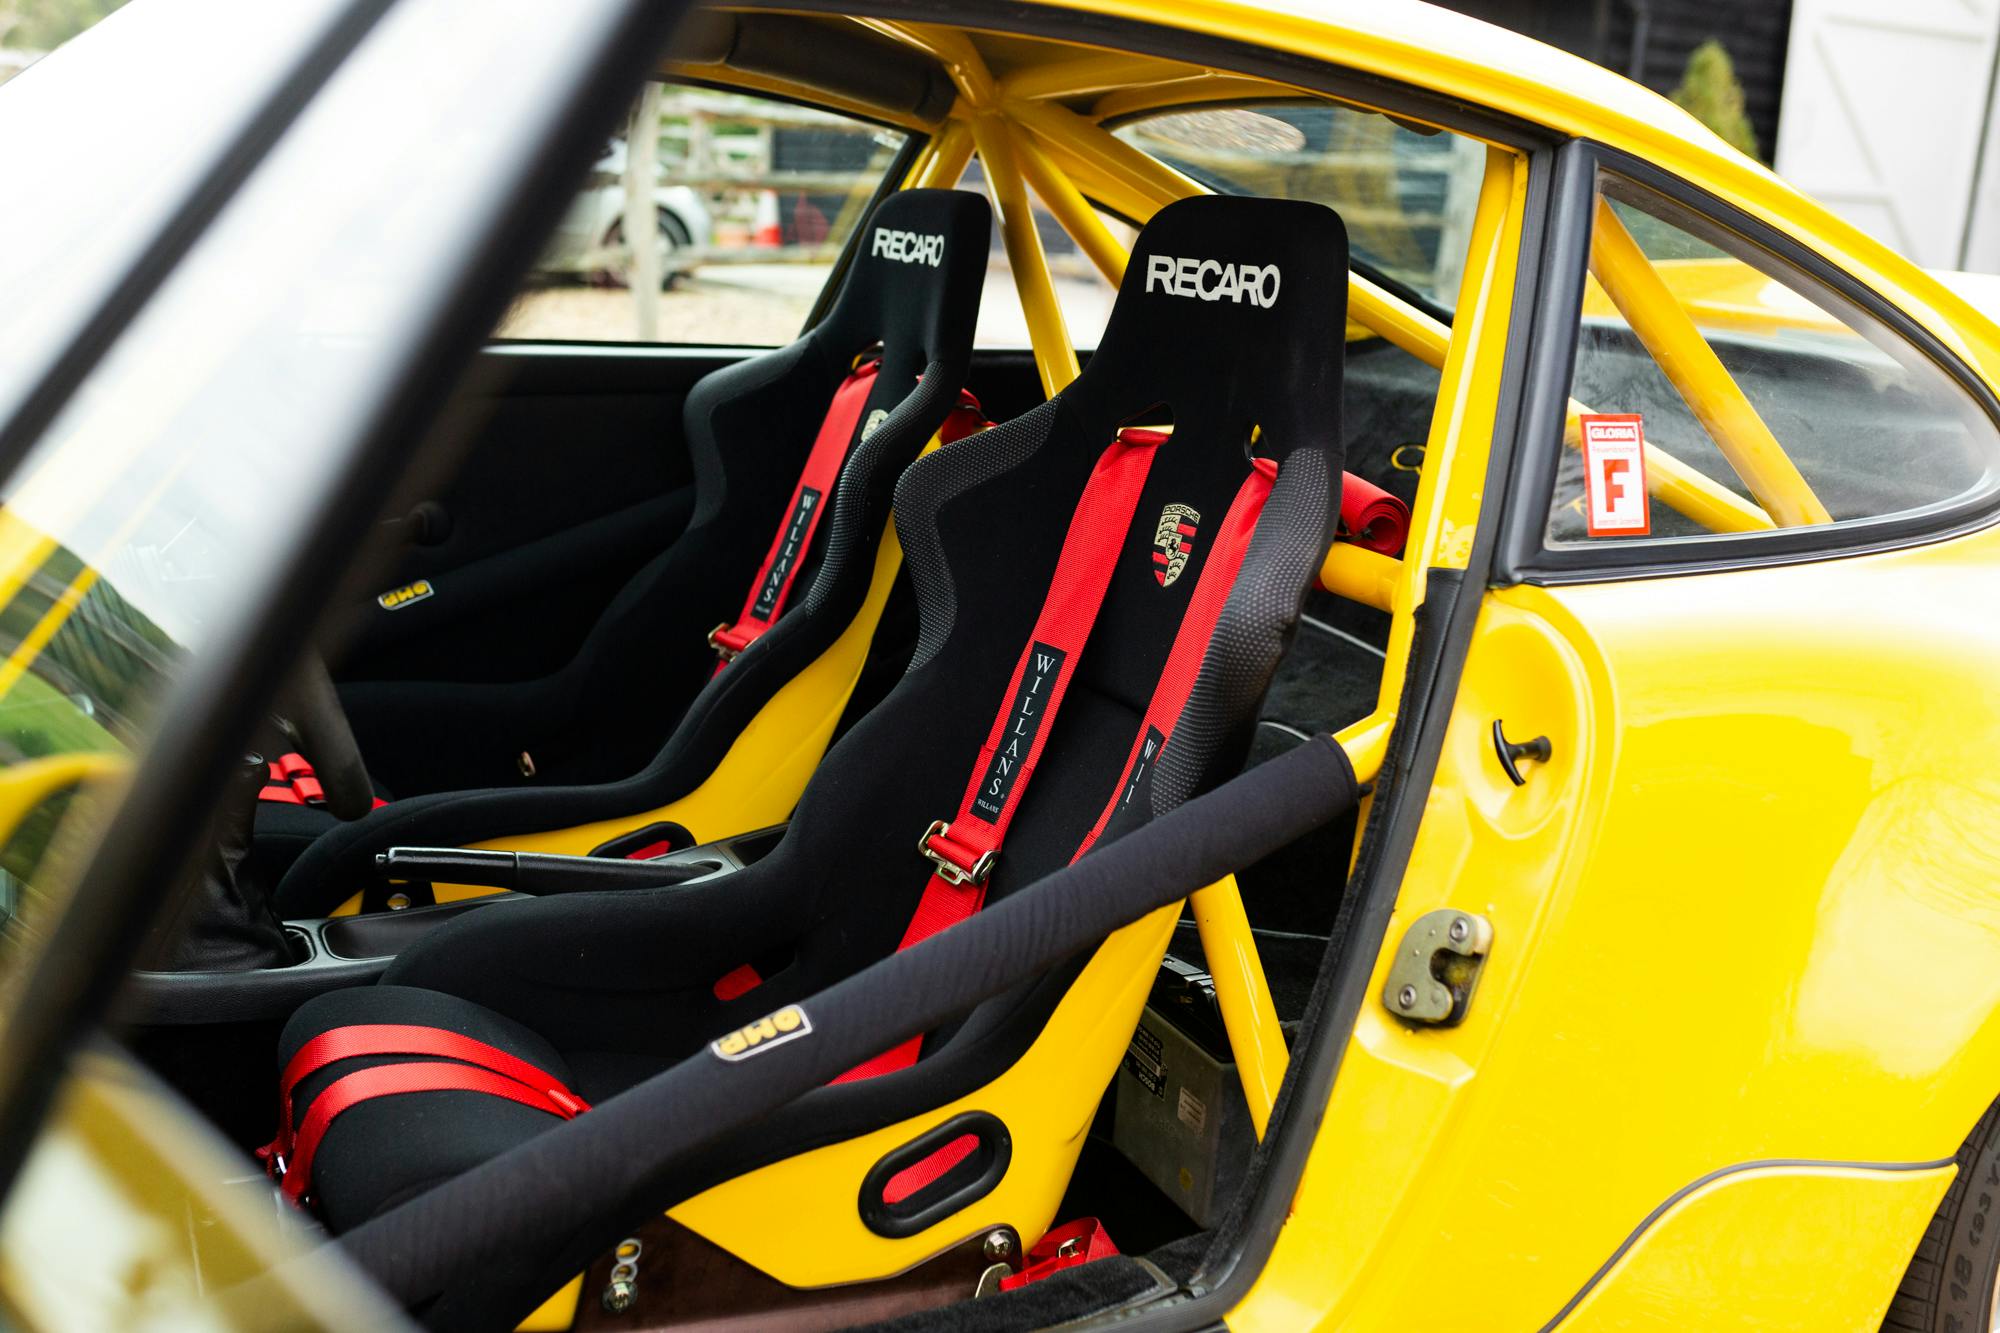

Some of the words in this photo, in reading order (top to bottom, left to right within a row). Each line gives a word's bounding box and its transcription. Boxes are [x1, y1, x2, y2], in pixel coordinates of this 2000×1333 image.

[872, 228, 944, 267] RECARO
[1146, 254, 1281, 308] RECARO
[1591, 428, 1635, 439] GLORIA
[1603, 459, 1629, 512] F
[1164, 505, 1200, 522] PORSCHE
[764, 494, 815, 603] WILLANS
[383, 582, 428, 607] OMP
[989, 652, 1055, 796] WILLANS
[720, 1008, 801, 1056] OMP
[1949, 1254, 1973, 1302] 18
